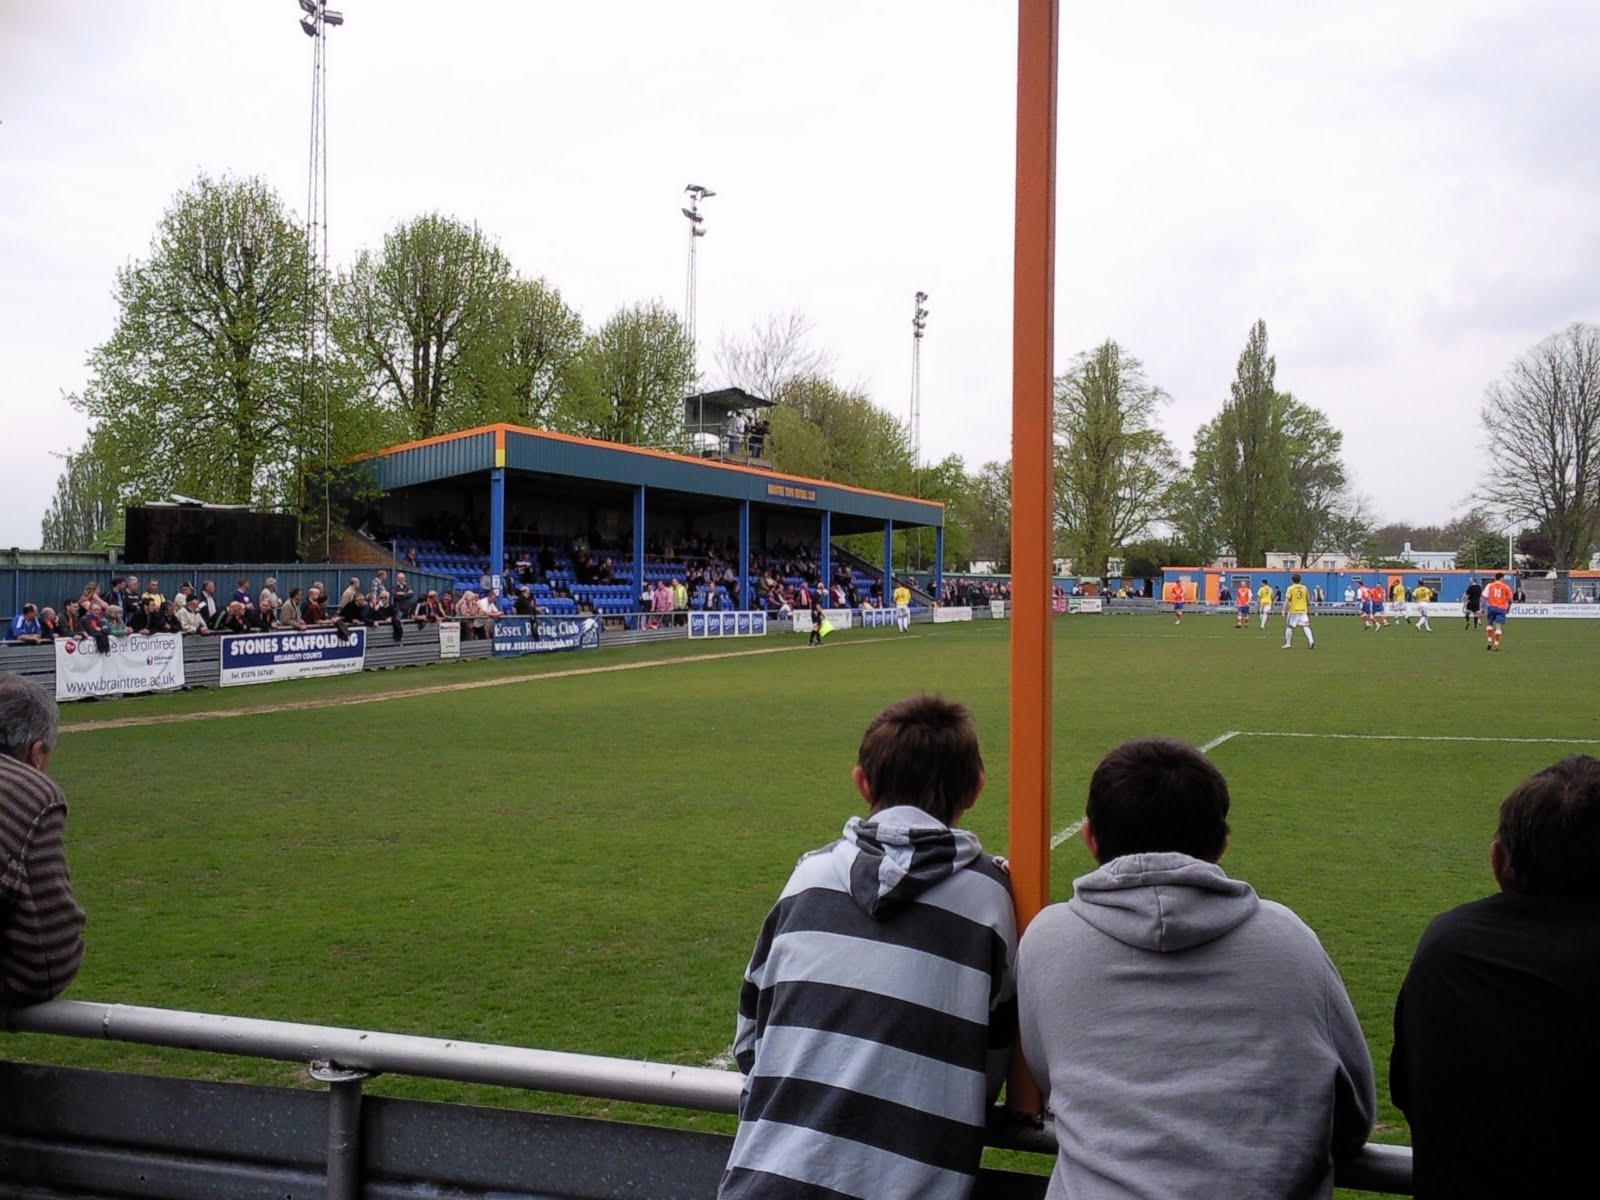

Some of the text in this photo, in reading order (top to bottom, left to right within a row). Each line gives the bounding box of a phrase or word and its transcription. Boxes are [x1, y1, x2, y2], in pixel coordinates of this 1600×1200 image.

[1493, 588, 1502, 598] 10
[494, 621, 579, 637] Essex Rcing Club
[78, 639, 118, 657] Coge
[131, 637, 176, 652] Braintree
[230, 638, 279, 656] STONES
[66, 672, 176, 693] www.braintree.ac.uk
